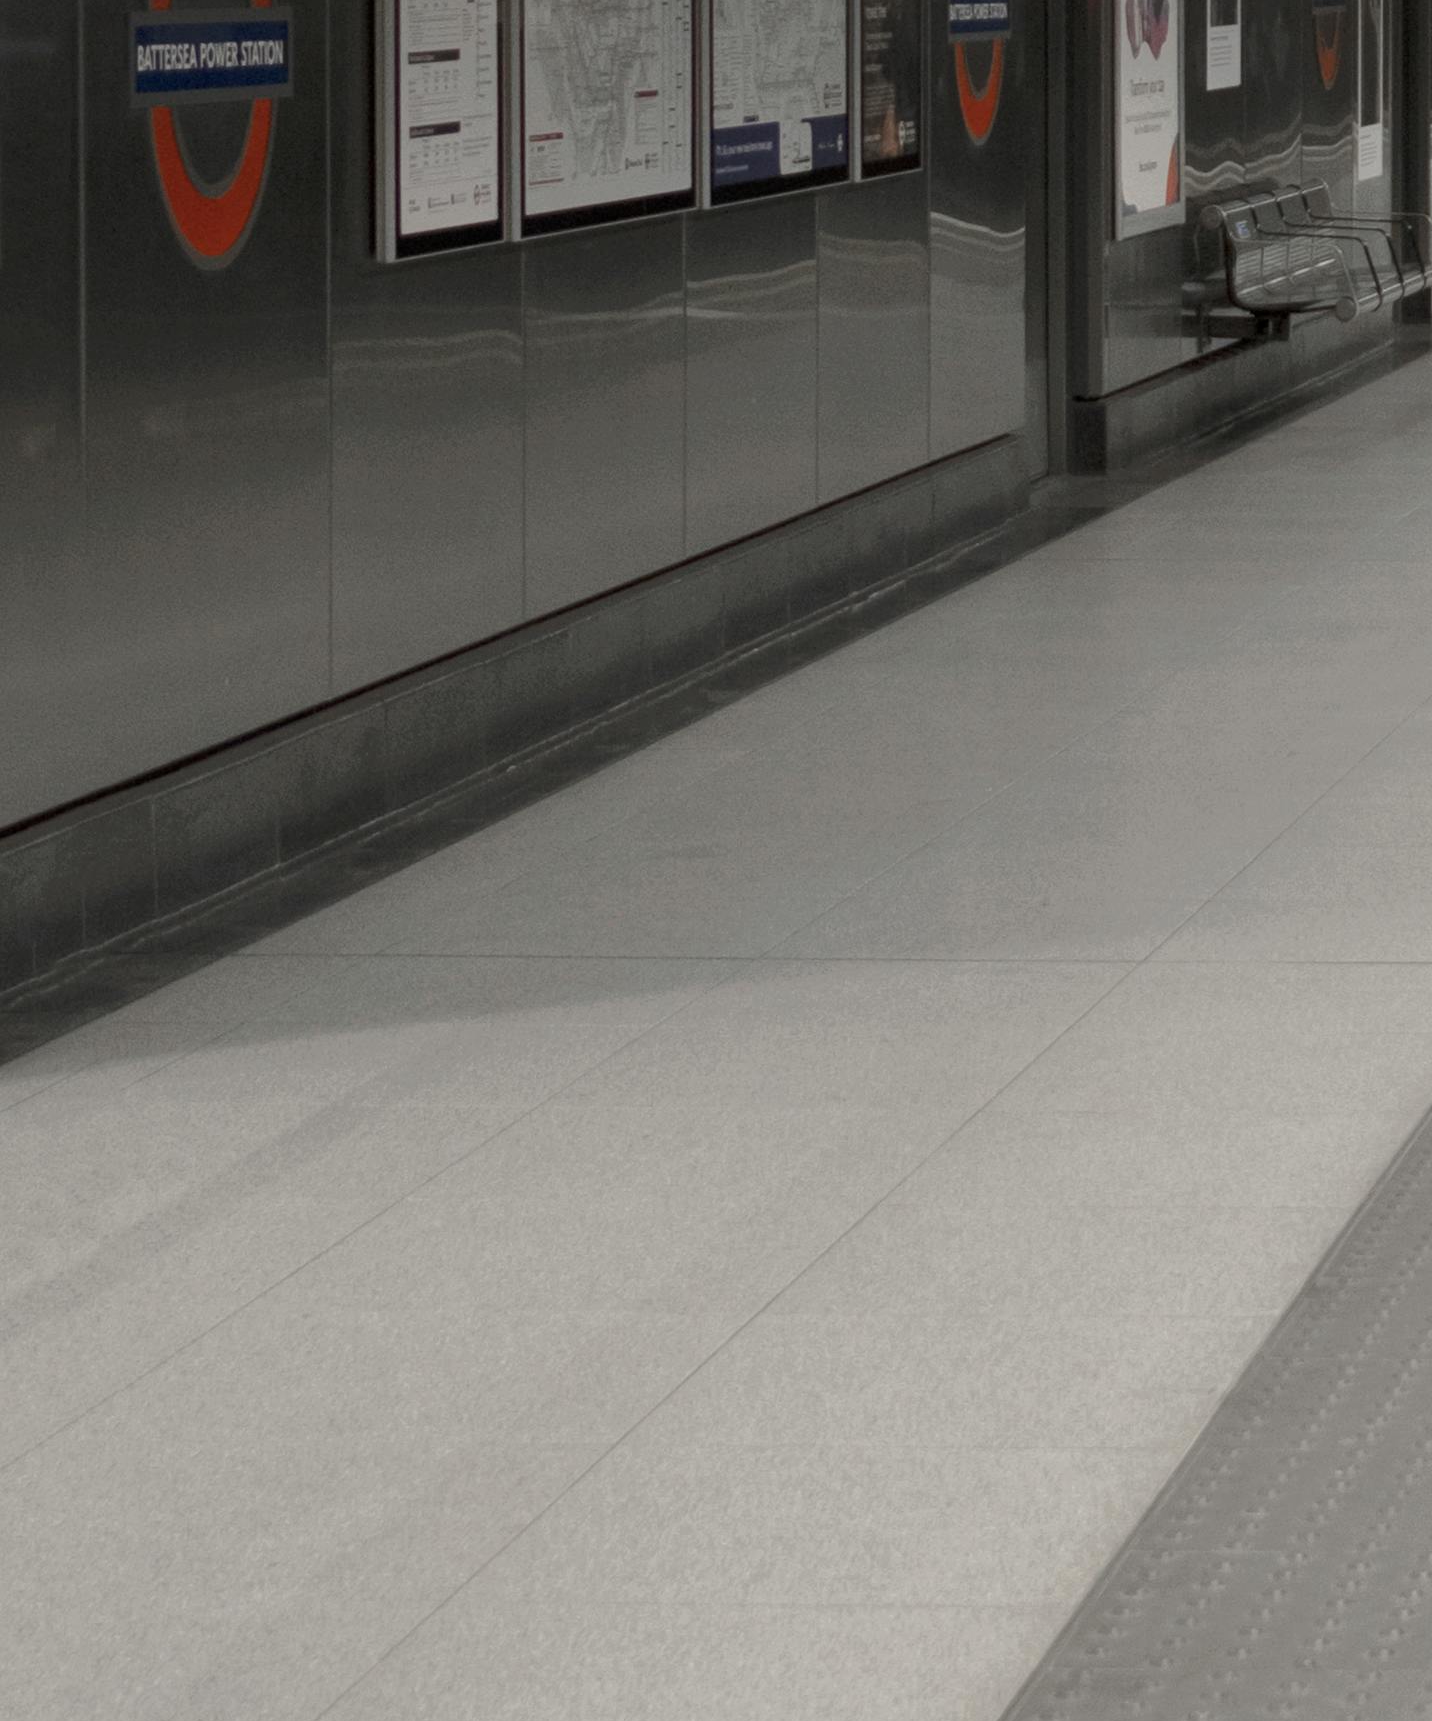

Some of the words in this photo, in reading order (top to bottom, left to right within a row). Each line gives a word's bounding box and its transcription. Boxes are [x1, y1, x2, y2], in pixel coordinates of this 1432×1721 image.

[136, 43, 198, 72] BATTERSEA
[199, 41, 239, 69] POWER
[241, 39, 284, 66] STATION
